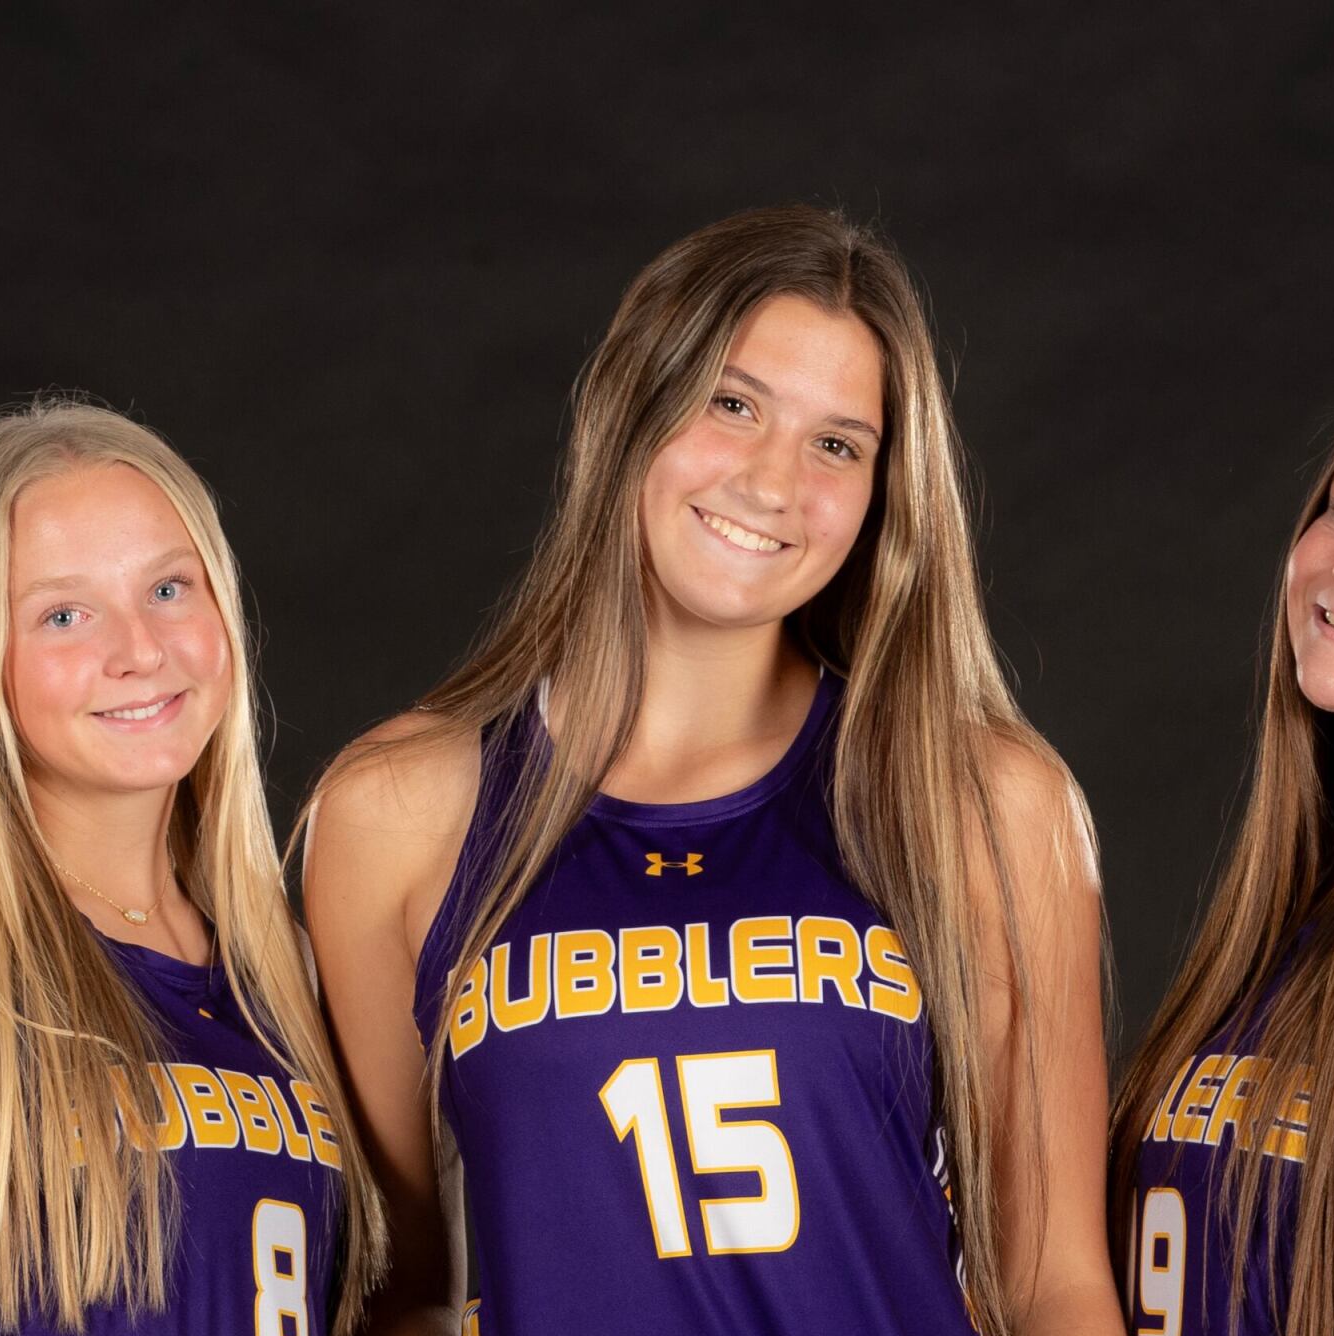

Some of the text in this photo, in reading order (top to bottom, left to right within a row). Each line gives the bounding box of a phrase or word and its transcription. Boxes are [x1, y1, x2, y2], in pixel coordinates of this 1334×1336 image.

[447, 915, 924, 1061] BUBBLERS
[69, 1062, 343, 1171] UBBLE
[598, 1049, 801, 1259] 15
[1142, 1054, 1317, 1164] LERS
